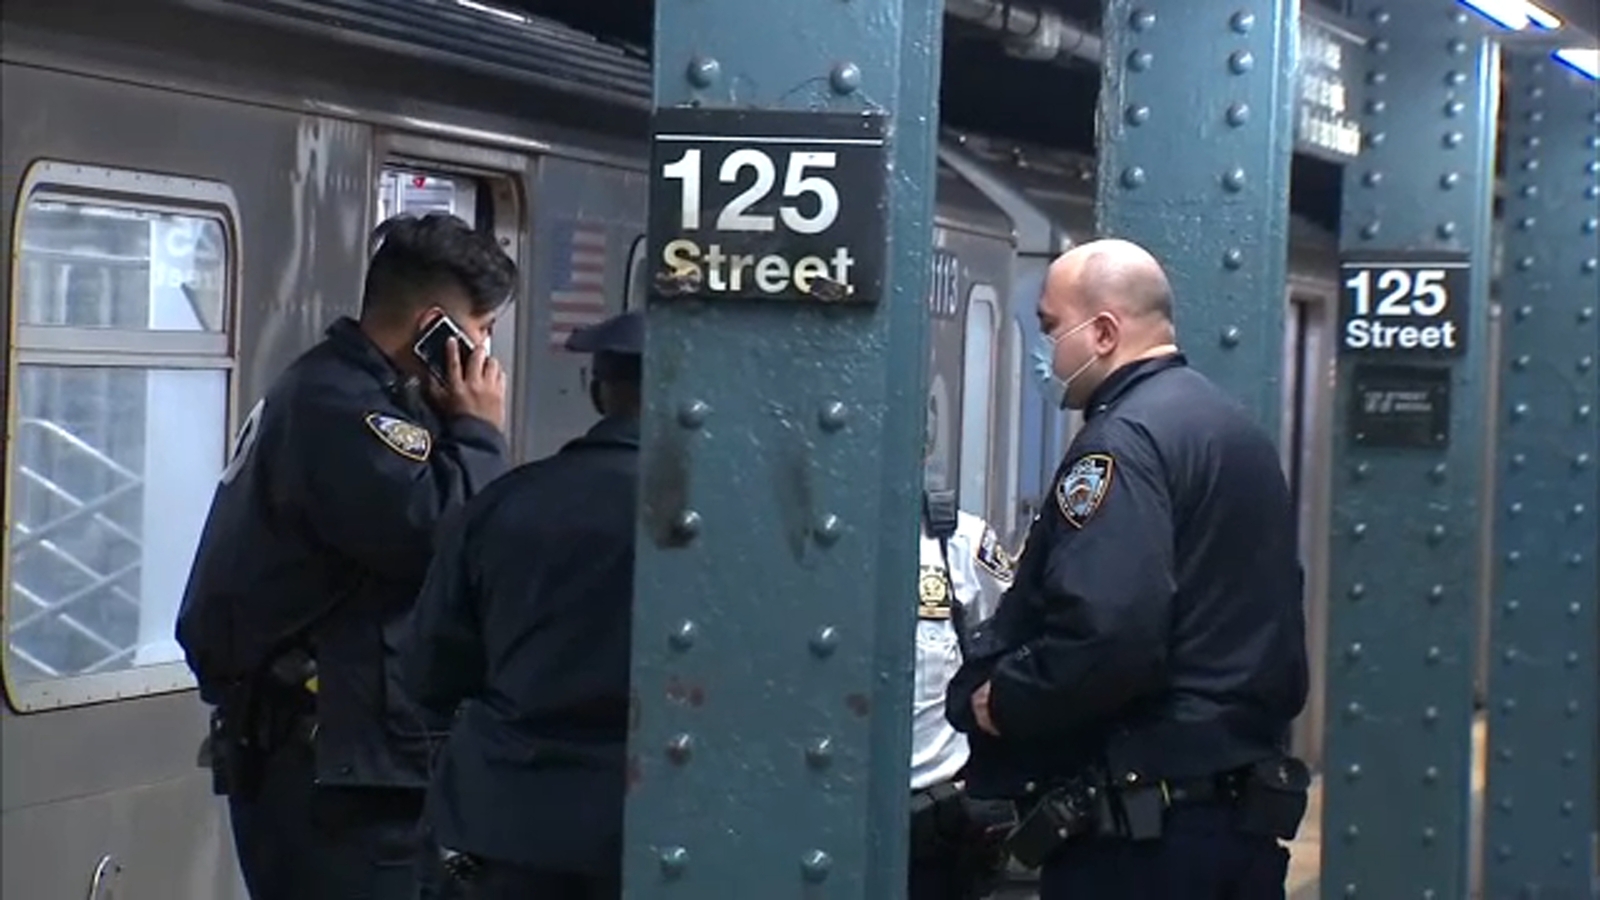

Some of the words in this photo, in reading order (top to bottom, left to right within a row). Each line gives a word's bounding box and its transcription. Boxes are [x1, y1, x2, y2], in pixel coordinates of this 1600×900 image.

[662, 148, 840, 235] 125
[662, 239, 855, 294] Street
[1345, 269, 1448, 317] 125
[1345, 319, 1457, 349] Street
